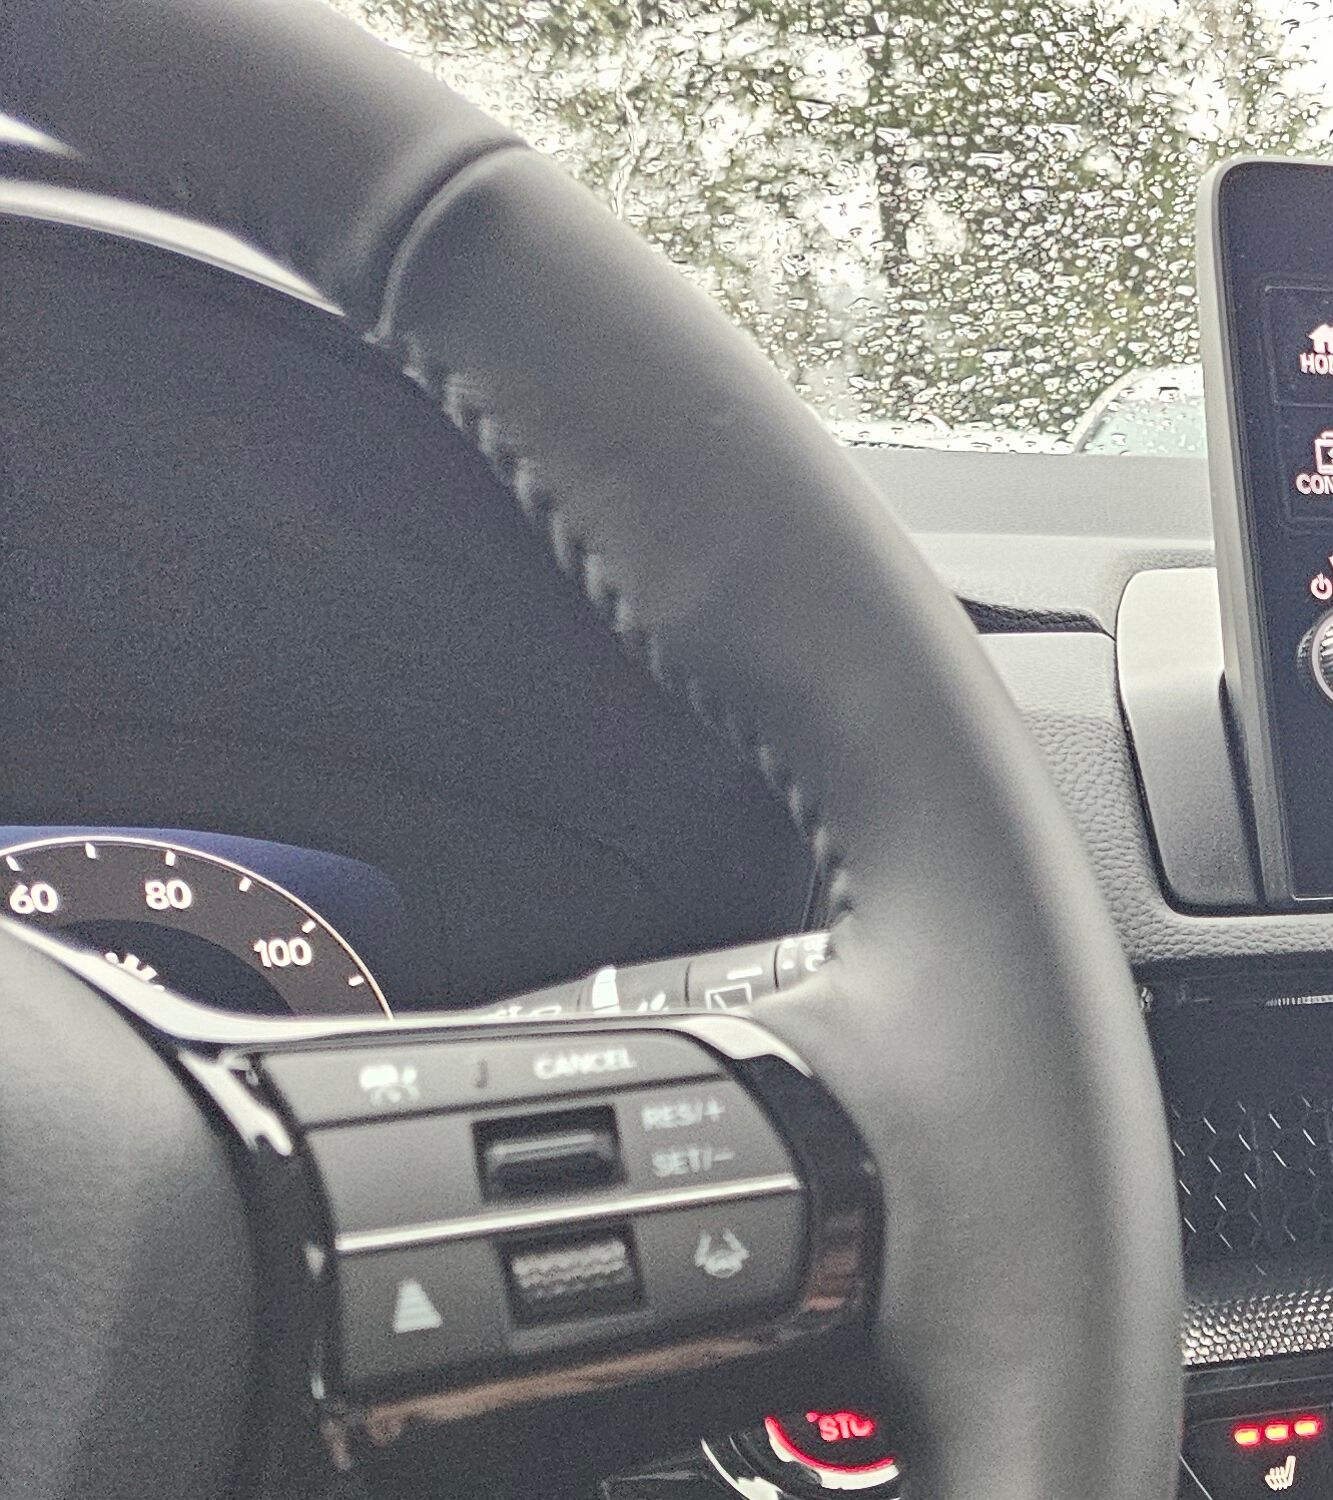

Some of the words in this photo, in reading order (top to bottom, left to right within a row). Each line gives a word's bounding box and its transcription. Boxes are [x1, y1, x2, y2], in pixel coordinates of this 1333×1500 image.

[9, 883, 59, 914] 60
[145, 879, 192, 910] 80
[253, 937, 313, 968] 100
[534, 1048, 635, 1080] CANCEL
